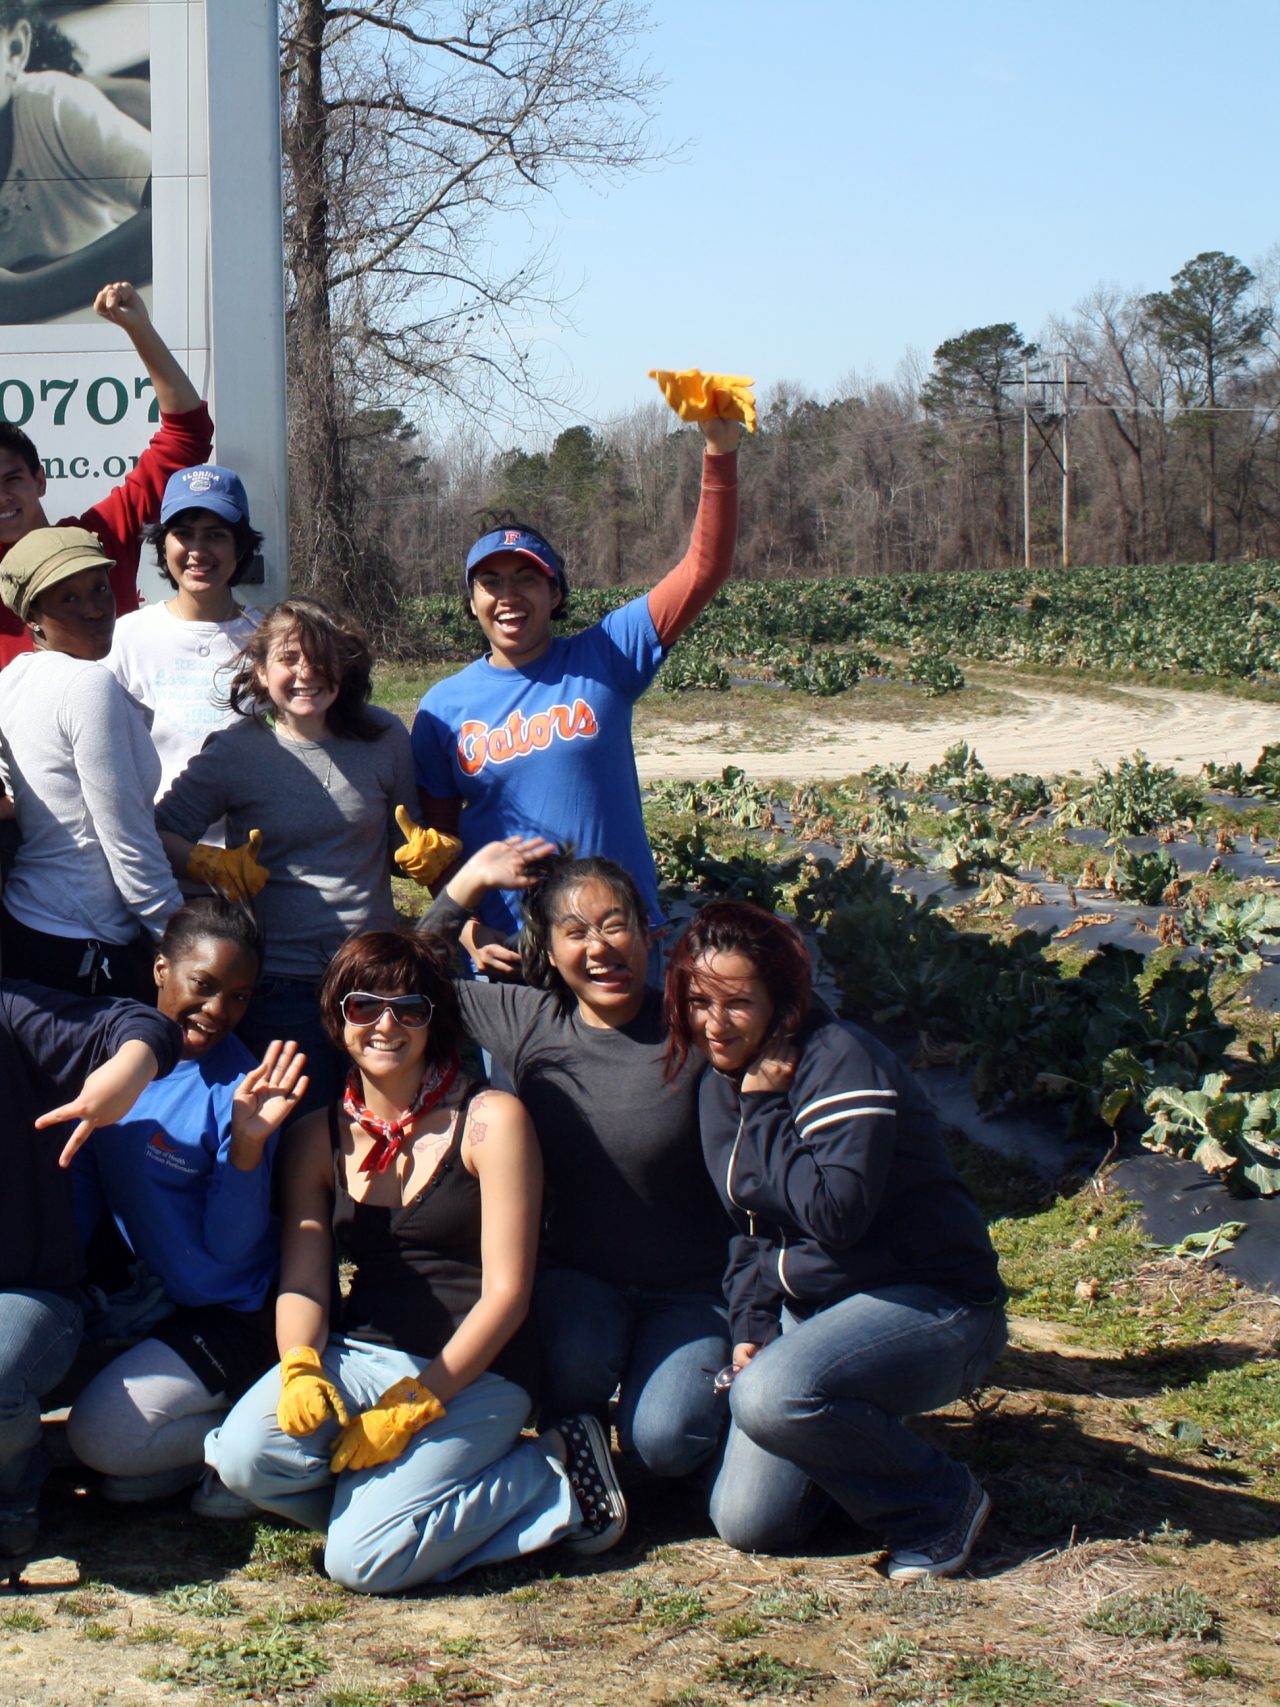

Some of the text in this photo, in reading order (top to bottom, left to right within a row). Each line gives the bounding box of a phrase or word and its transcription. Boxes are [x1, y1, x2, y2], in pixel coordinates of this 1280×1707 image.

[181, 471, 220, 481] FLORIDA
[503, 530, 522, 546] F
[457, 698, 599, 777] Gators
